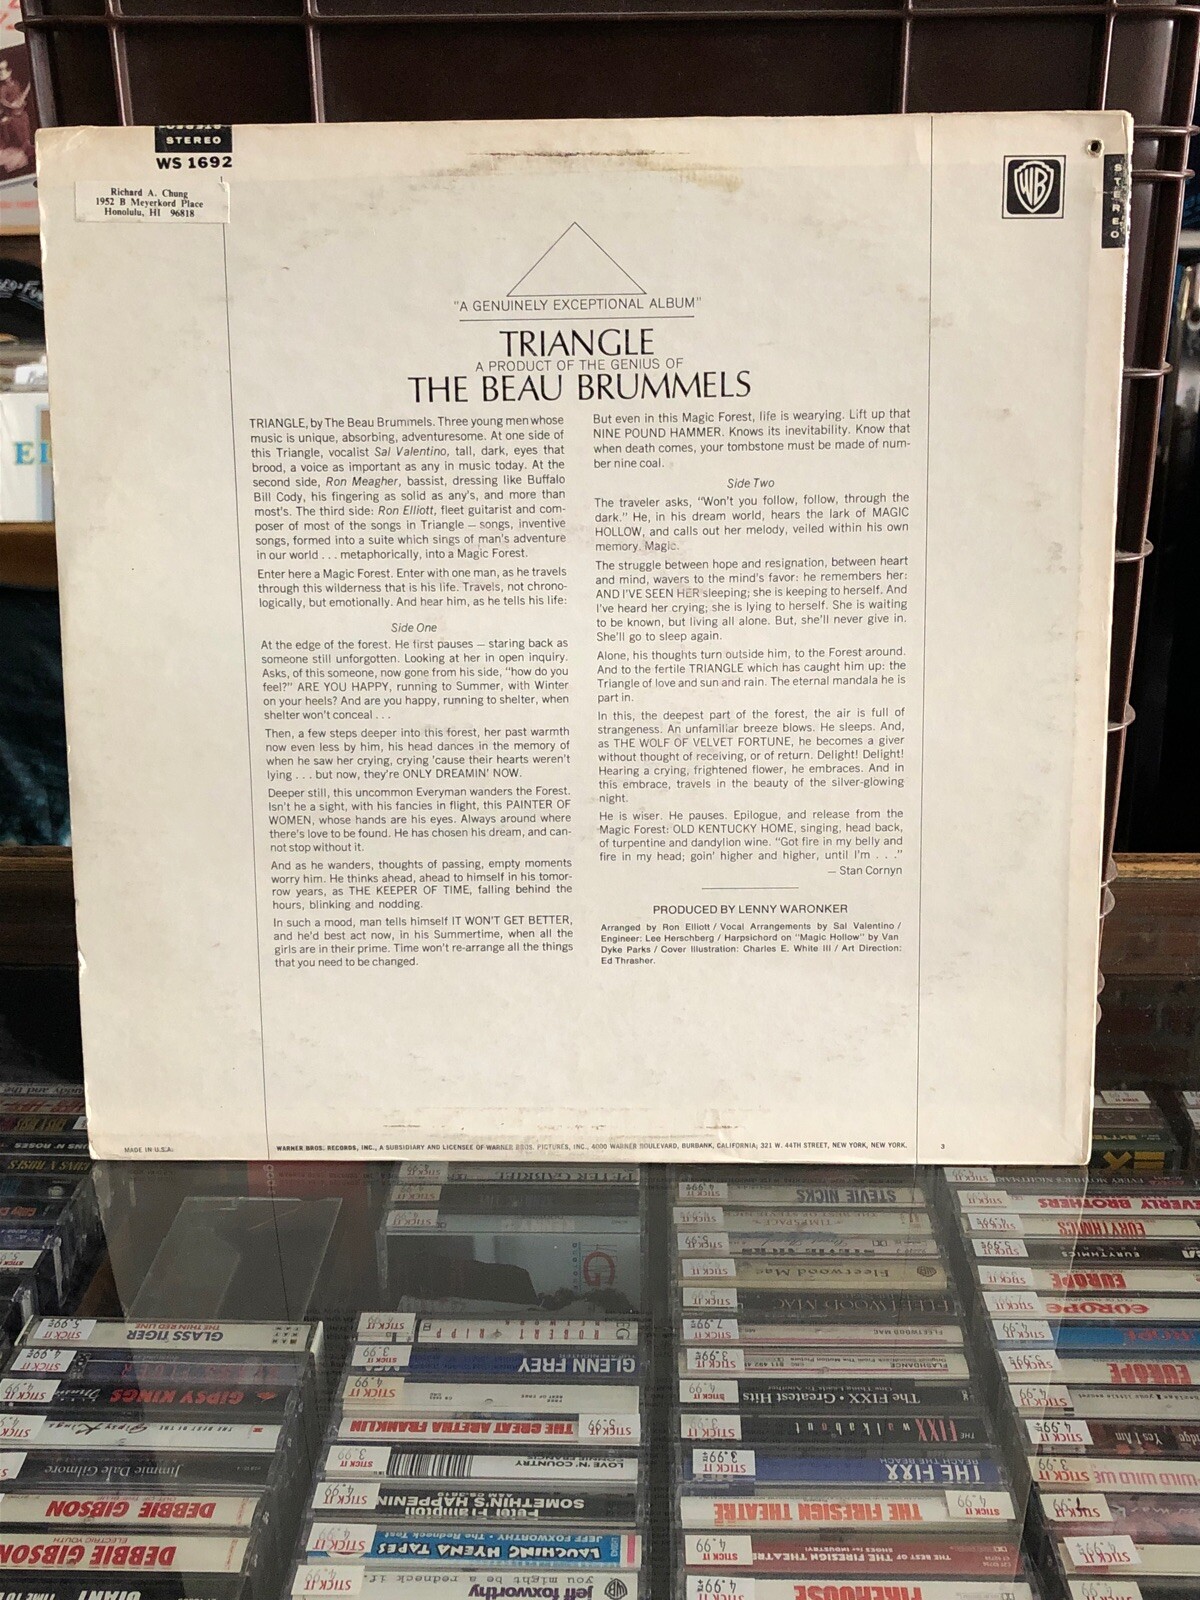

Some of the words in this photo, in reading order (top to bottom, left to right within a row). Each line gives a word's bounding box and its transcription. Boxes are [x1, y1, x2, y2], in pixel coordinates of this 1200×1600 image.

[166, 136, 221, 144] STEREO
[156, 157, 182, 169] WS
[188, 156, 232, 169] 1692
[111, 188, 142, 196] Richard
[148, 189, 157, 197] A.
[162, 189, 188, 199] Chung
[120, 198, 126, 206] B
[131, 198, 176, 208] Meyerkord
[181, 198, 204, 208] Place
[1110, 163, 1122, 239] STEREO
[105, 208, 144, 217] Honolulu,
[150, 209, 161, 217] HI
[170, 209, 194, 217] 96818
[473, 299, 548, 311] GENUINELY
[553, 297, 644, 311] EXCEPTIONAL
[649, 296, 702, 309] ALBUM"
[500, 328, 654, 357] TRIANGLE
[475, 361, 484, 372] A
[489, 360, 552, 371] PRODUCT
[556, 360, 575, 371] OF
[581, 359, 605, 371] THE
[611, 358, 660, 370] GENIUS
[665, 358, 684, 369] OF
[408, 376, 469, 403] THE
[482, 374, 563, 402] BEAU
[578, 370, 751, 401] BRUMMELS
[249, 418, 308, 430] TRIANGLE,
[311, 417, 323, 431] by
[324, 417, 345, 428] The
[347, 417, 374, 427] Beau
[377, 416, 435, 427] Brummels.
[437, 416, 469, 426] Three
[471, 417, 503, 429] young
[506, 416, 528, 426] men
[530, 415, 564, 425] whose
[593, 428, 621, 438] NINE
[624, 427, 666, 438] POUND
[669, 427, 724, 437] HAMMER.
[728, 426, 764, 437] Knows
[768, 426, 780, 436] its
[785, 424, 851, 437] inevitability.
[855, 424, 885, 434] Know
[889, 423, 910, 434] that
[727, 478, 751, 488] Side
[754, 478, 775, 488] Two
[391, 622, 415, 633] Side
[417, 623, 437, 633] One
[840, 866, 863, 876] Stan
[866, 866, 903, 878] Cornyn
[653, 904, 718, 915] PRODUCED
[721, 904, 736, 914] BY
[738, 904, 778, 914] LENNY
[780, 904, 848, 914] WARONKER
[276, 1144, 304, 1152] WARNER
[306, 1144, 325, 1152] BROS.
[327, 1144, 359, 1153] RECORDS,
[361, 1144, 378, 1152] INC.,
[495, 1172, 571, 1181] GABRIEL
[575, 1172, 634, 1182] PETER
[796, 1189, 839, 1203] NICKS
[847, 1190, 896, 1203] STEVIE
[1038, 1199, 1132, 1209] BROTHERS
[1057, 1221, 1146, 1237] EURYTHMICS
[756, 1267, 791, 1277] Mac
[797, 1268, 889, 1278] Fleetwood
[1049, 1273, 1126, 1289] EUROPE
[126, 1329, 171, 1341] TIGER
[174, 1330, 223, 1342] GLASS
[517, 1357, 567, 1373] FREY
[570, 1357, 636, 1372] GLENN
[1107, 1363, 1191, 1384] EUROPE
[354, 1377, 383, 1387] 4.99
[110, 1388, 177, 1404] KINGS
[181, 1390, 244, 1404] GIPSY
[348, 1387, 361, 1398] IT
[363, 1388, 396, 1398] STICK
[742, 1392, 772, 1404] Hits
[775, 1392, 836, 1404] Greatest
[847, 1392, 889, 1403] FIXX
[892, 1393, 920, 1403] The
[350, 1421, 428, 1432] FRANKLIN
[432, 1421, 490, 1434] ARETHA
[491, 1422, 542, 1434] GREAT
[545, 1423, 573, 1434] THE
[915, 1418, 957, 1441] FIXX
[960, 1431, 975, 1439] THE
[1115, 1432, 1132, 1443] Am
[1143, 1433, 1162, 1444] Yes
[1038, 1458, 1066, 1470] 3.99
[44, 1465, 98, 1477] Gilmore
[101, 1465, 130, 1480] Dale
[134, 1464, 181, 1478] Jimmie
[884, 1463, 934, 1483] FIXX
[942, 1463, 983, 1483] THE
[1038, 1470, 1053, 1481] IT
[1056, 1471, 1089, 1481] STICK
[1120, 1472, 1155, 1484] WILD
[474, 1497, 584, 1508] SOMETHIN'S
[957, 1495, 987, 1507] 4.99
[45, 1501, 130, 1518] GIBSON
[139, 1502, 216, 1518] DEBBIE
[713, 1502, 793, 1523] THEATRE
[796, 1503, 882, 1522] FIRESIGN
[886, 1503, 923, 1522] THE
[965, 1507, 974, 1515] IT
[976, 1507, 1000, 1516] STICK
[496, 1534, 571, 1542] FOXWORTHY
[0, 1544, 86, 1565] GIBSON
[90, 1545, 177, 1566] DEBBIE
[377, 1543, 430, 1556] TAPES
[438, 1544, 501, 1558] HYENA
[508, 1545, 600, 1559] LAUGHING
[396, 1575, 458, 1584] redneck
[486, 1576, 502, 1584] be
[513, 1575, 558, 1585] might
[567, 1575, 593, 1584] you
[468, 1584, 559, 1600] foxworthy
[564, 1586, 593, 1600] jeff
